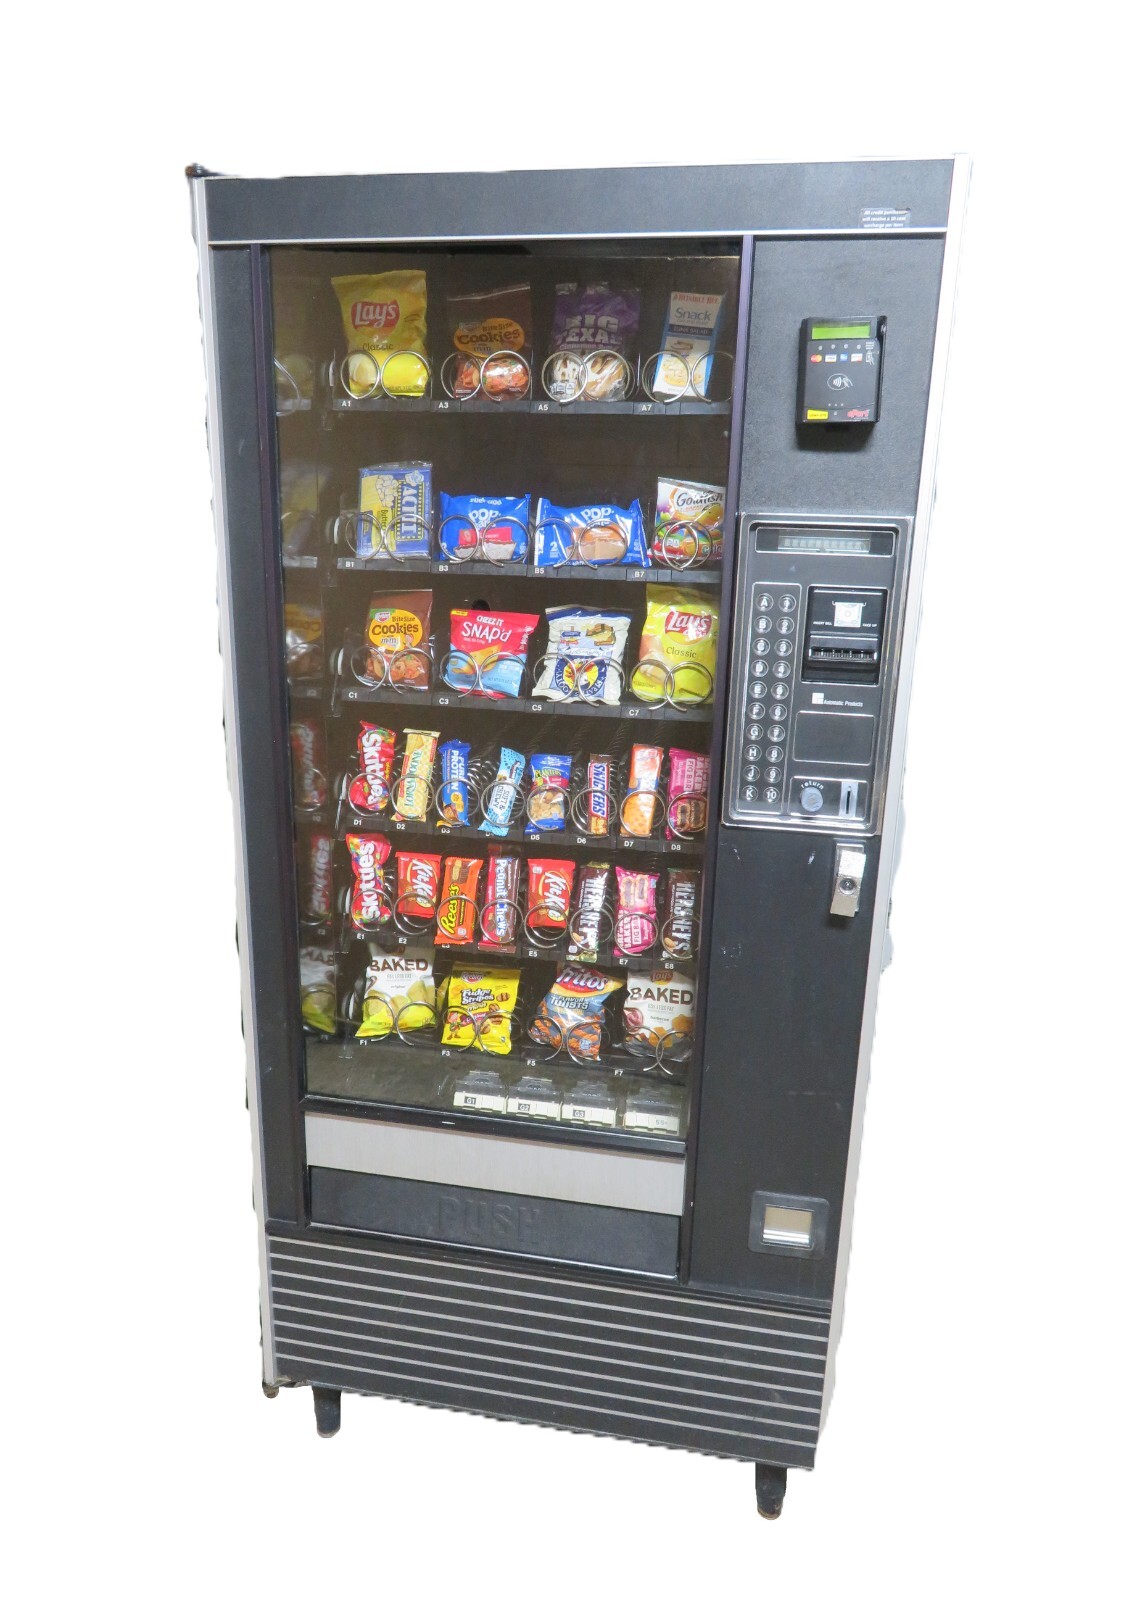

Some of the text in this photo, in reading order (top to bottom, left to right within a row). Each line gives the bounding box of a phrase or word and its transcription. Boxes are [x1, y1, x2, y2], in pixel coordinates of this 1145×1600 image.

[674, 307, 712, 321] Snack
[457, 329, 521, 345] Cookies
[641, 404, 652, 412] A7
[438, 564, 449, 572] B3
[534, 567, 545, 575] B5
[760, 598, 768, 608] A
[758, 620, 767, 629] B
[371, 623, 420, 636] Cookies
[666, 647, 698, 659] Classic
[348, 691, 358, 699] C1
[438, 697, 449, 705] C3
[628, 709, 640, 717] C7
[753, 706, 760, 715] F
[750, 727, 758, 736] G
[749, 748, 757, 757] H
[747, 769, 754, 778] J
[800, 780, 825, 791] return
[500, 790, 510, 803] SOFT
[746, 789, 753, 798] K
[766, 790, 777, 799] 10
[496, 859, 508, 898] Peanut
[398, 937, 407, 945] E2
[370, 958, 429, 972] BAKED
[462, 988, 491, 998] Fudge
[630, 987, 693, 1005] BAKED
[462, 994, 495, 1004] Stripes
[551, 997, 588, 1010] TWISTS
[574, 1110, 584, 1118] G3
[438, 1195, 540, 1244] PUSH
